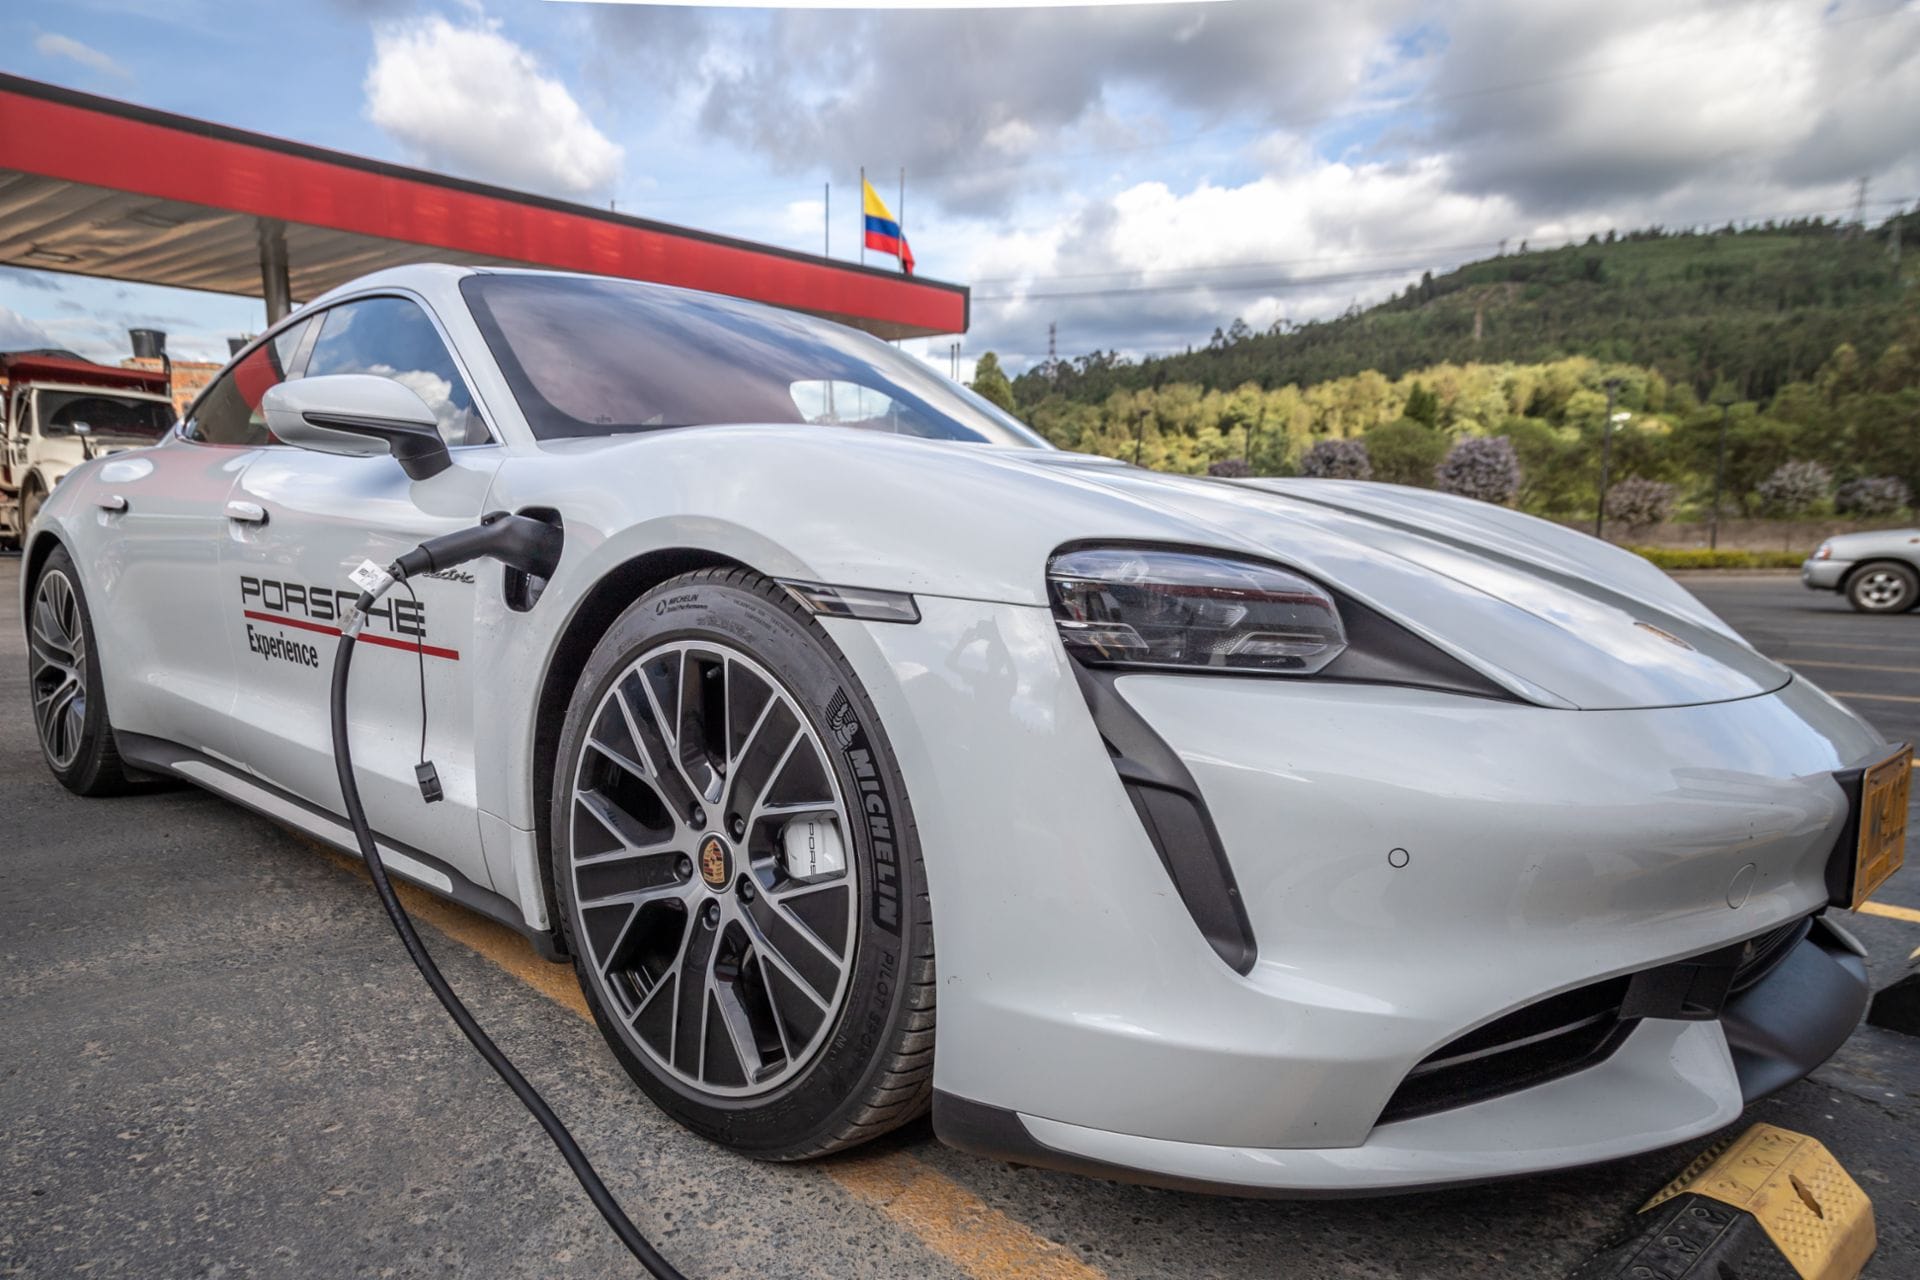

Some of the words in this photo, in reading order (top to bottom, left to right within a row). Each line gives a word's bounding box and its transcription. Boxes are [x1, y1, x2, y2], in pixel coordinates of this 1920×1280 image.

[246, 623, 319, 668] Experience
[849, 748, 897, 926] MICHELIN
[874, 950, 895, 1009] PILOT
